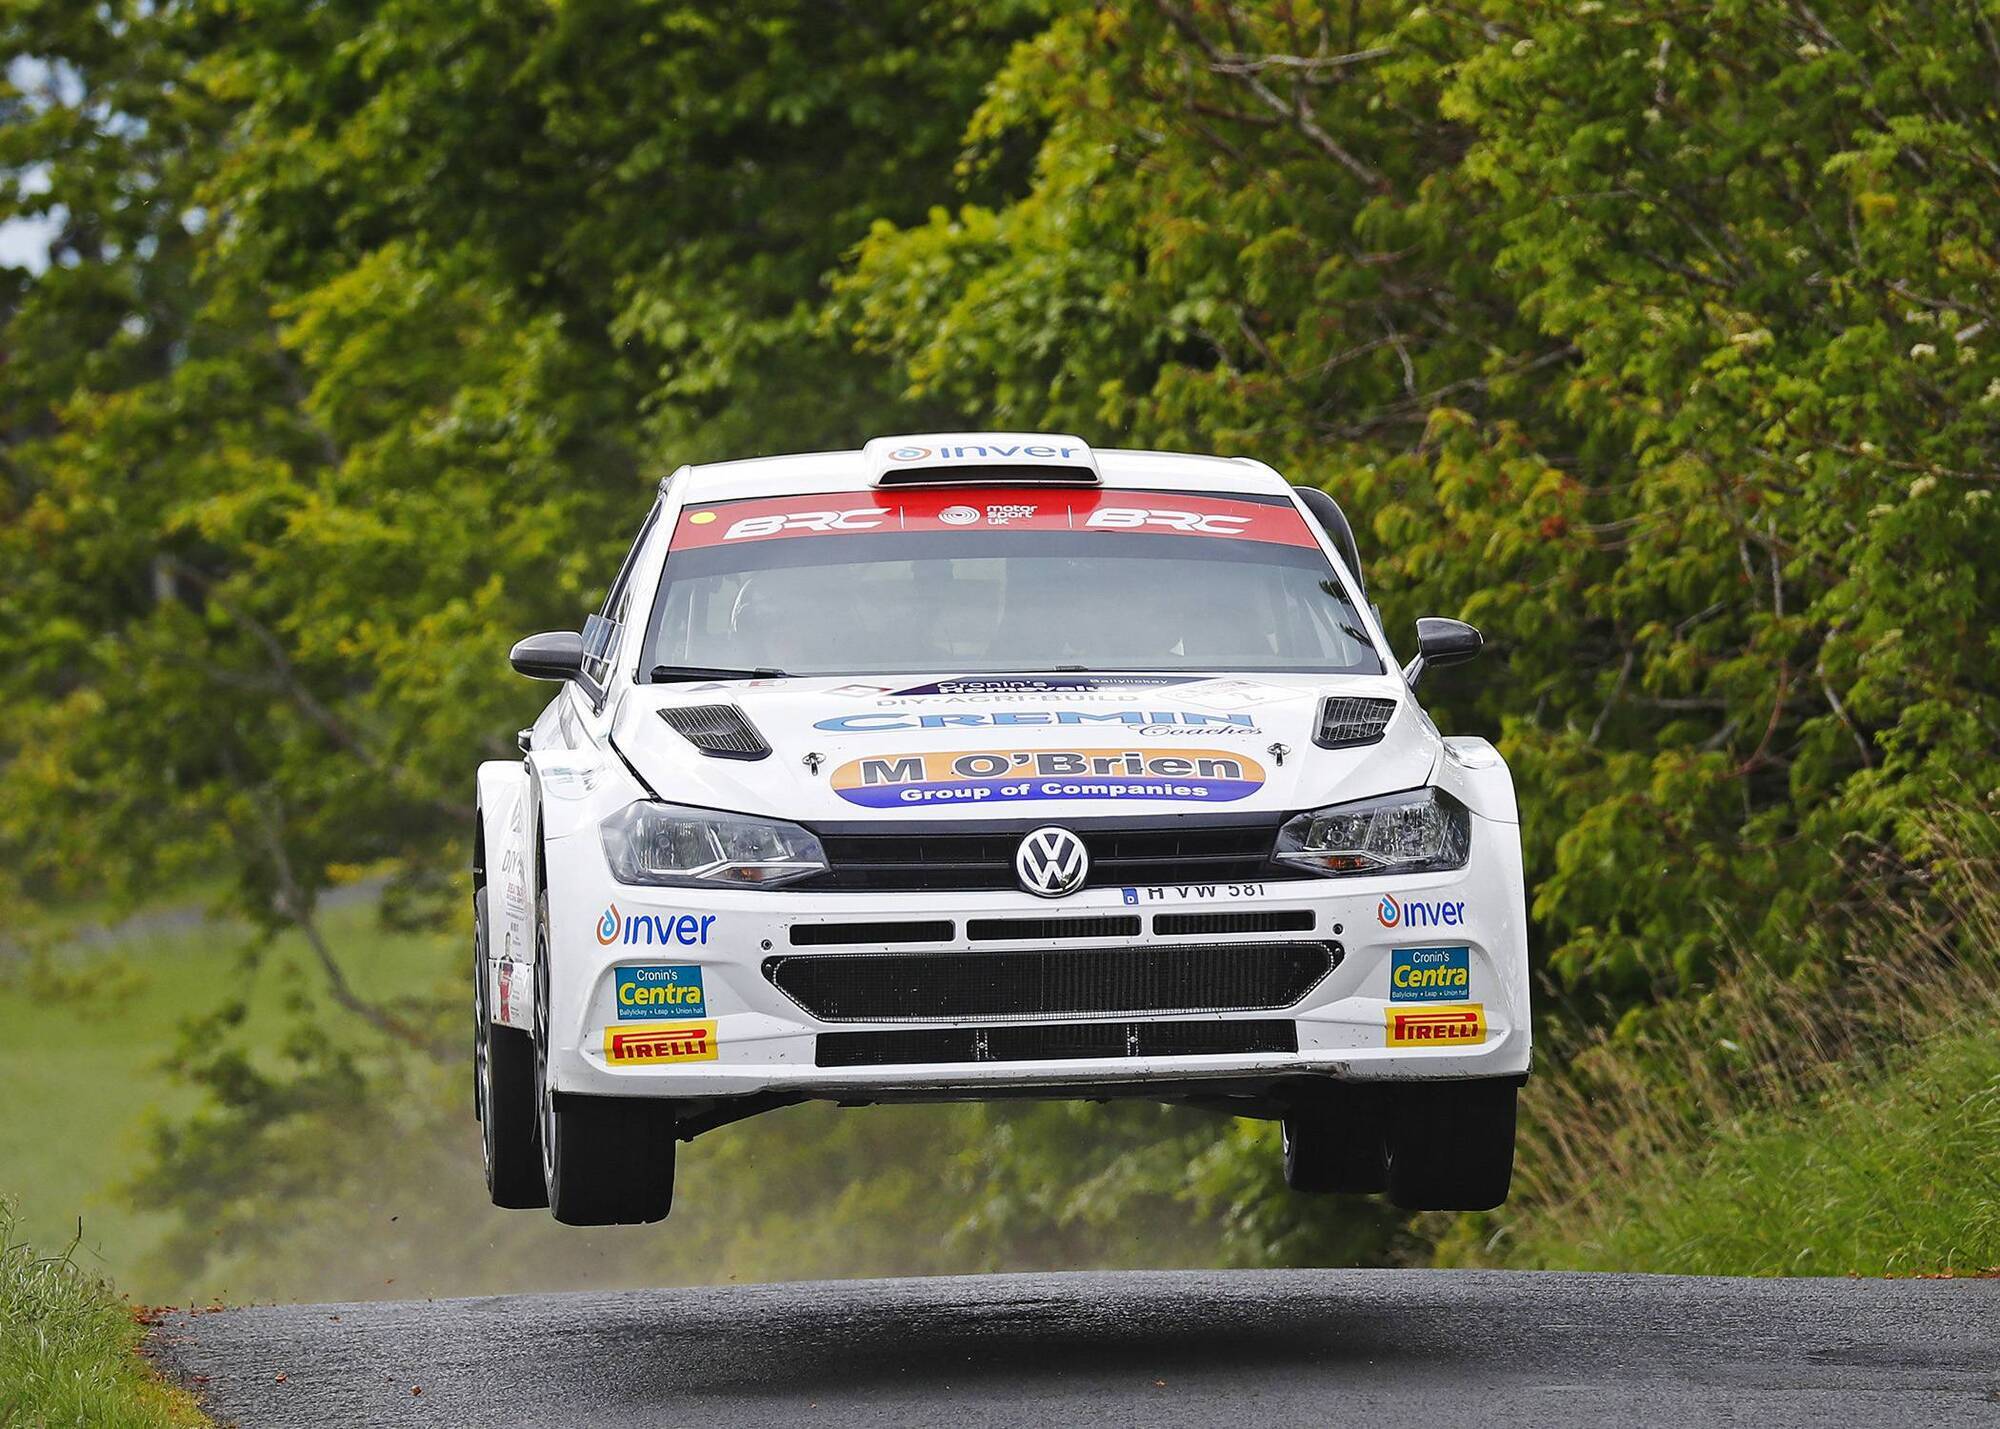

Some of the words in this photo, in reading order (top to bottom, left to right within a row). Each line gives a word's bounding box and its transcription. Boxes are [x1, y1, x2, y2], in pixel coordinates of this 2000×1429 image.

[941, 446, 1081, 459] inver
[723, 508, 892, 540] BRC
[987, 511, 1033, 519] sport
[1085, 508, 1253, 534] BRC
[937, 680, 1048, 689] Cronin's
[813, 711, 1254, 732] CREMIN
[1130, 724, 1263, 737] Coaches
[862, 757, 925, 785] M
[950, 752, 1242, 780] O'Brien
[900, 784, 991, 801] Group
[1001, 783, 1030, 796] of
[1041, 783, 1209, 798] Companies
[1403, 901, 1466, 928] inver
[623, 914, 717, 946] inver
[1412, 950, 1451, 964] Cronin's
[636, 968, 679, 982] Cronin's
[1393, 963, 1468, 989] Centra
[618, 982, 703, 1006] Centra
[1393, 1012, 1479, 1041] PIRELLI
[611, 1027, 708, 1060] PIRELLI
